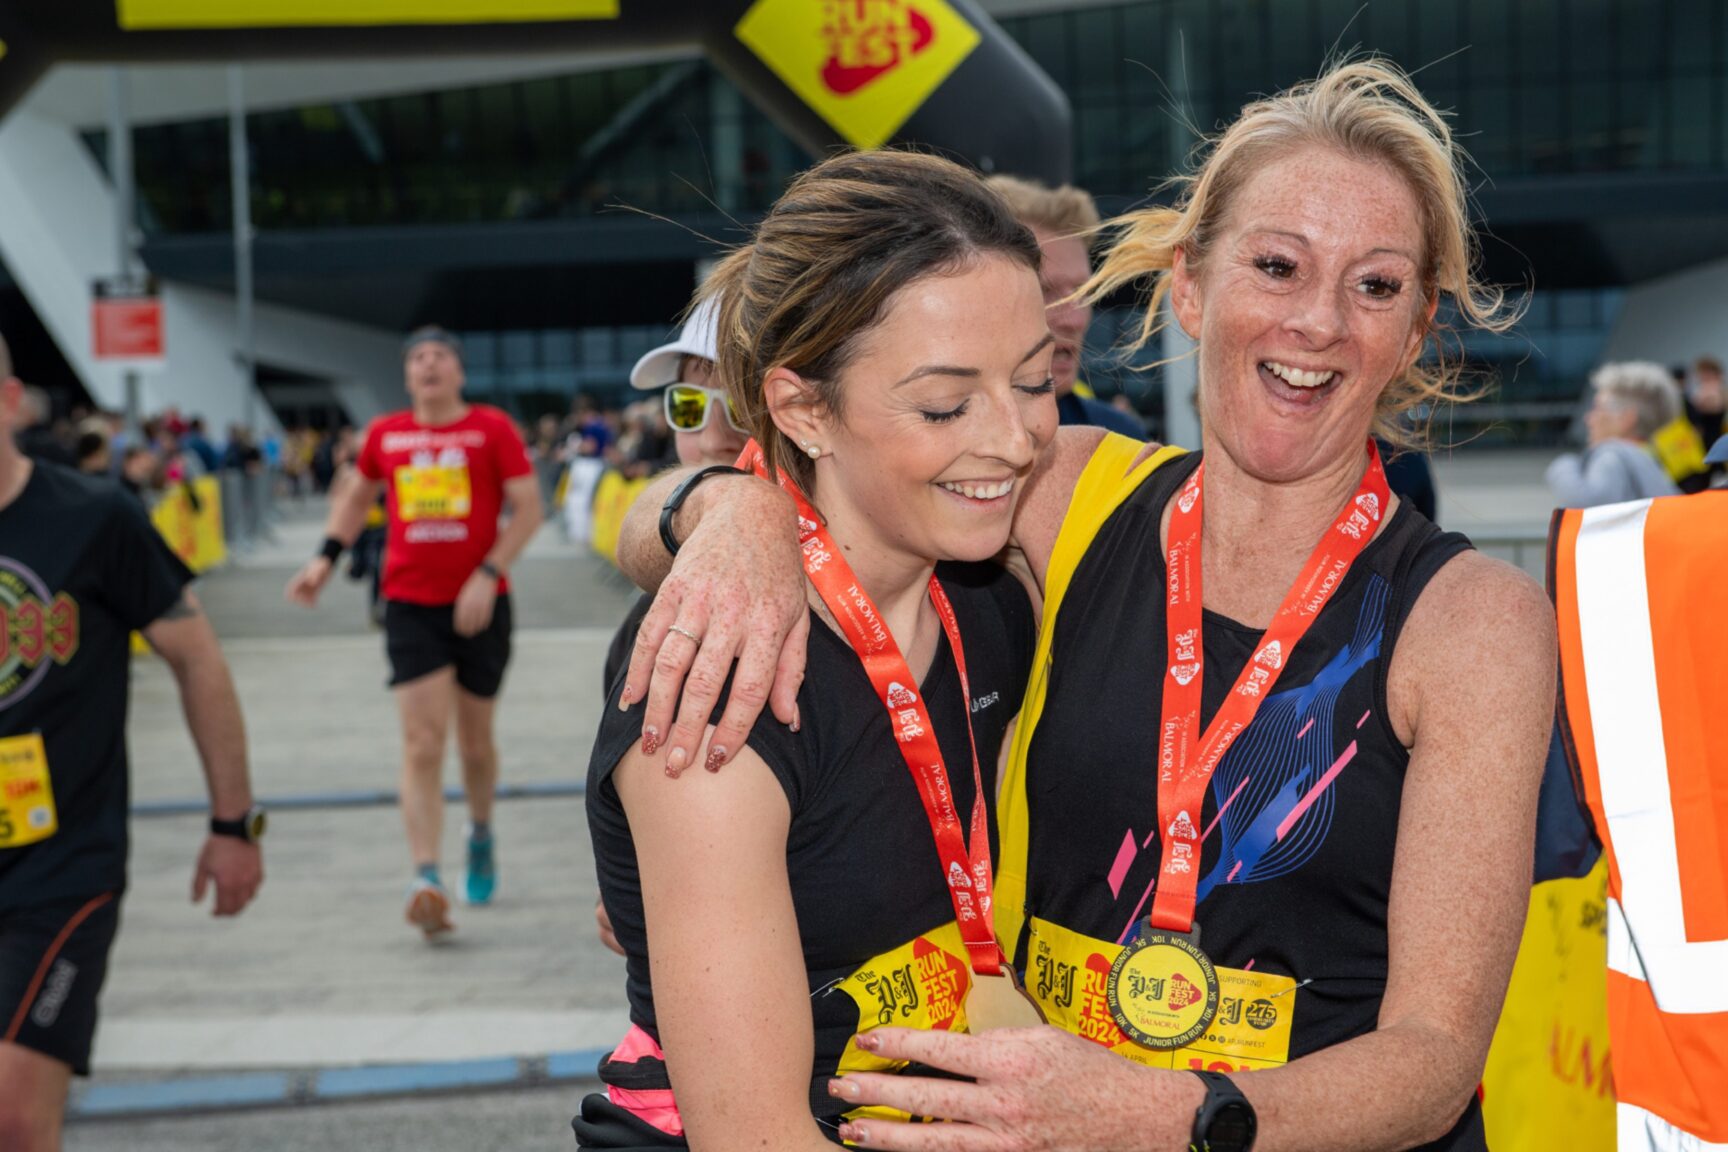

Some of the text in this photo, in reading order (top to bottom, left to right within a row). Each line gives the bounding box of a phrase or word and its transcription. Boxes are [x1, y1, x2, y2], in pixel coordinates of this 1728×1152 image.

[1169, 550, 1178, 607] BALMORAL
[1307, 559, 1347, 613] BALMORAL
[848, 583, 887, 643] BALMORAL
[1163, 722, 1175, 783] BALMORAL
[1203, 722, 1242, 772] BALMORAL
[931, 763, 954, 821] BALMORAL
[916, 949, 948, 978] RUN
[1134, 934, 1215, 984] JUNIOR FUN RUN 10K 5K
[855, 964, 919, 1025] The P&J
[922, 969, 958, 1000] FEST
[1037, 955, 1078, 1008] P&J
[1084, 969, 1108, 996] RU
[1108, 945, 1139, 1038] JUNIOR FUN RUN 10K 5K
[1128, 975, 1167, 1001] P&J
[1170, 989, 1195, 999] FEST
[1171, 980, 1191, 990] RUN
[1219, 975, 1262, 988] SUPPORTING
[928, 995, 958, 1021] 2024
[1140, 1018, 1180, 1030] BALMORAL
[1143, 991, 1216, 1045] JUNIOR FUN RUN 10K 5K
[1247, 1002, 1276, 1019] 275
[1079, 1015, 1121, 1045] 2024
